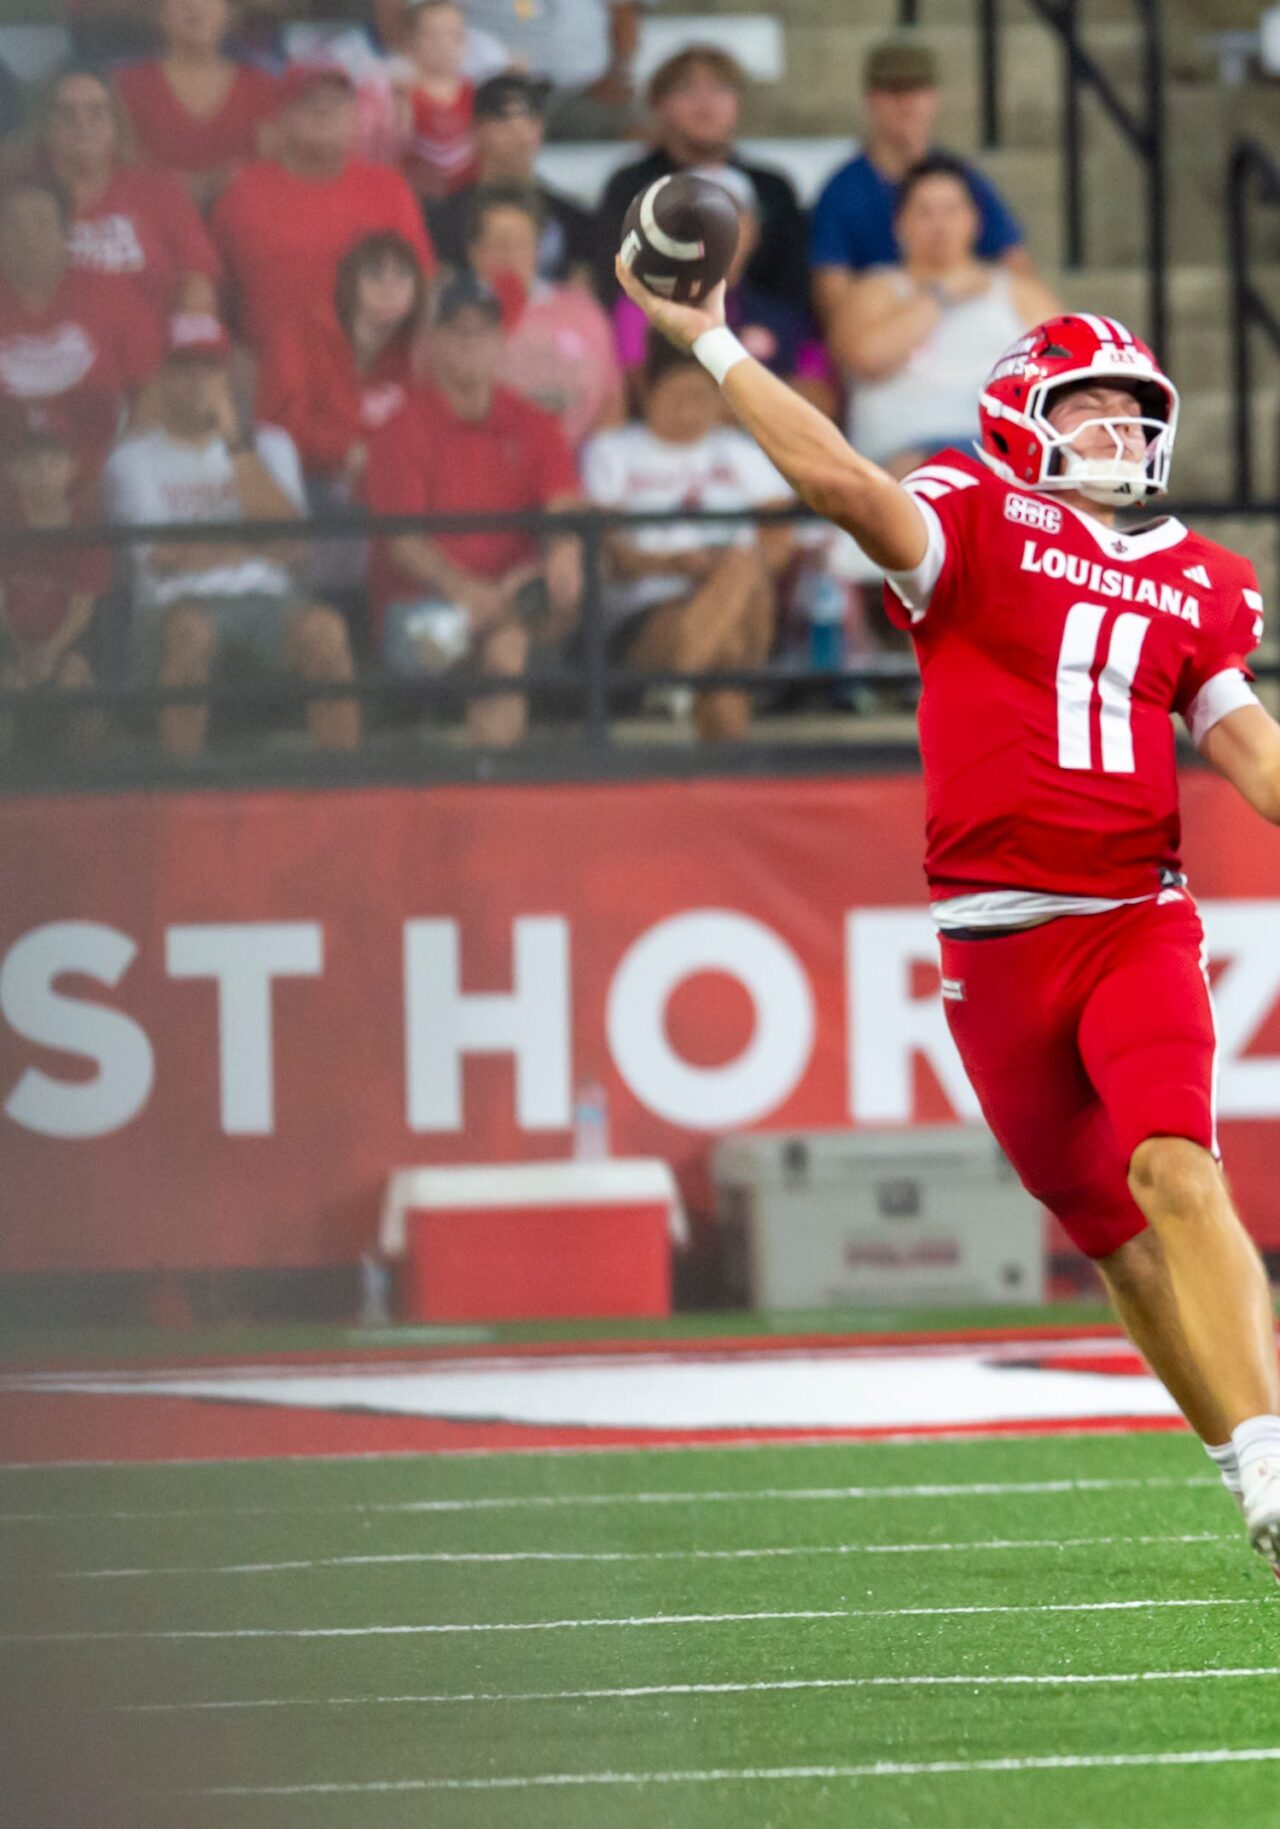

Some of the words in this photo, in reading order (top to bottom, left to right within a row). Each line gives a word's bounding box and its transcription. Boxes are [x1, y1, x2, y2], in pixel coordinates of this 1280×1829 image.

[1020, 540, 1200, 629] LOUISIANA
[1056, 602, 1151, 773] 11
[0, 918, 324, 1138] ST
